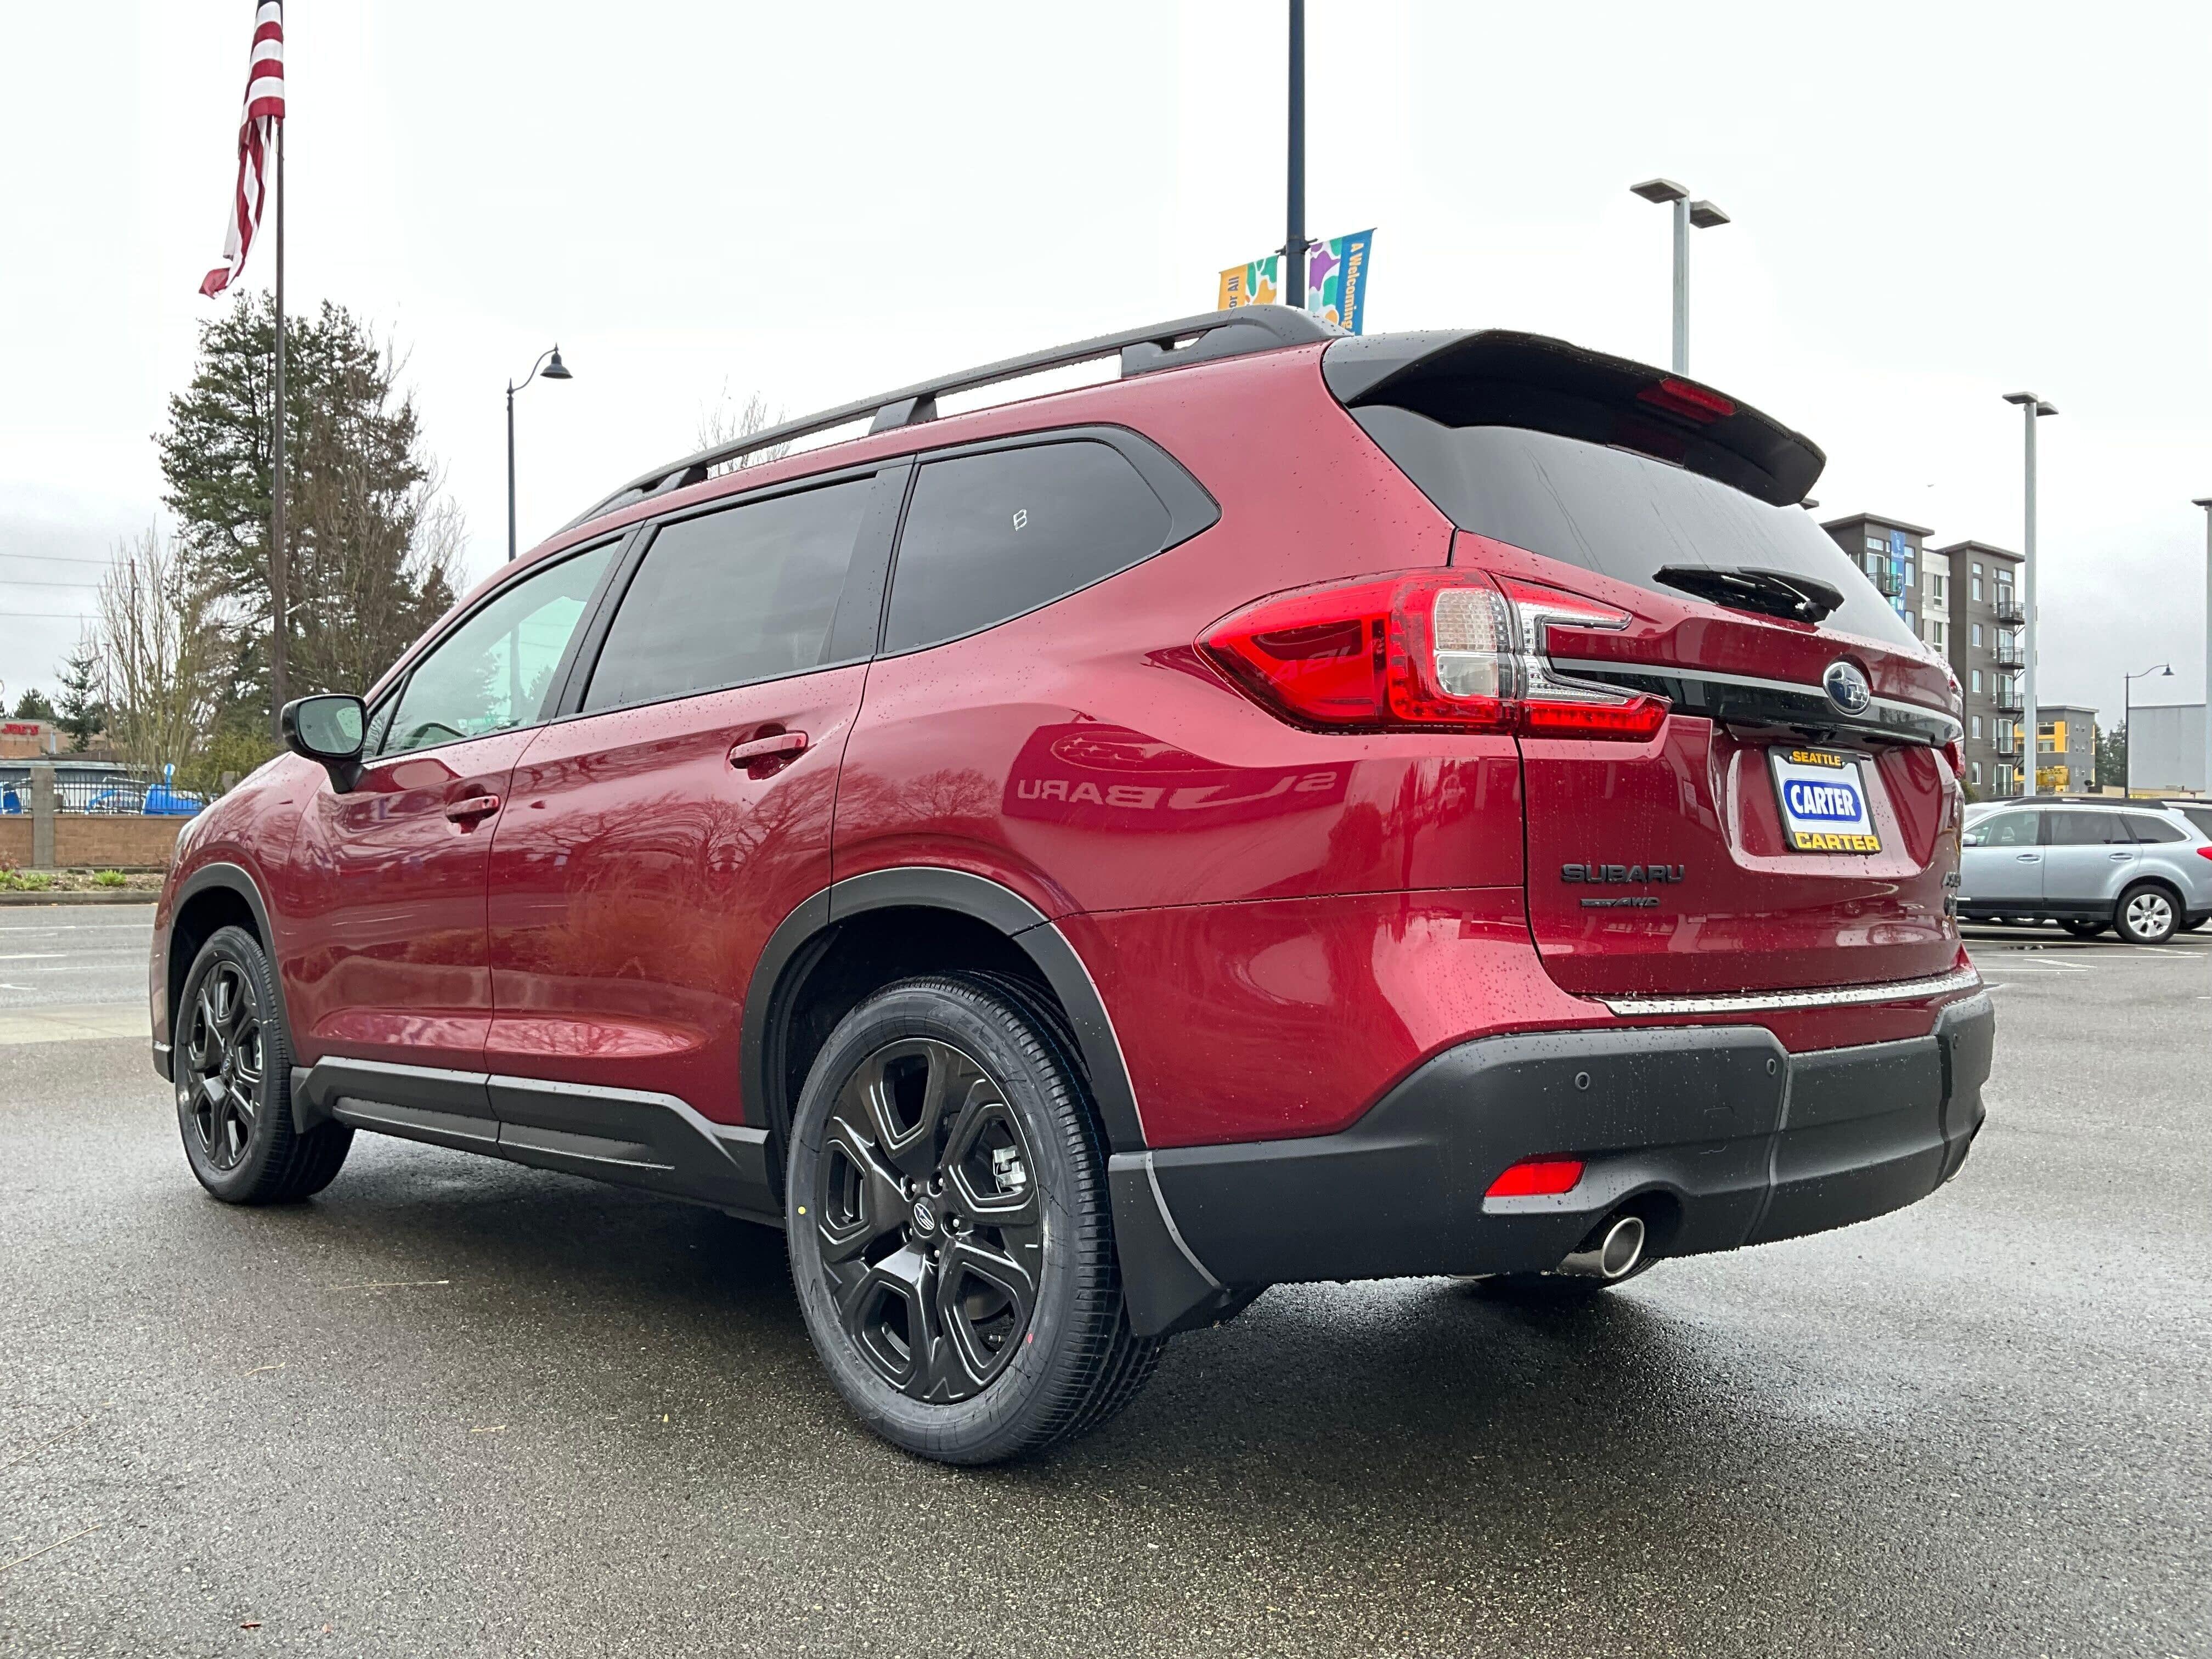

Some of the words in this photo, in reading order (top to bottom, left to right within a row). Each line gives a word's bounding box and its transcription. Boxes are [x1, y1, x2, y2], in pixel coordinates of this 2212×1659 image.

[1351, 243, 1364, 252] A
[1228, 276, 1239, 292] All
[1341, 252, 1362, 329] Welcoming
[1229, 296, 1238, 308] or
[1792, 751, 1841, 766] SEATTLE
[1791, 785, 1856, 816] CARTER
[1795, 832, 1881, 850] CARTER
[1561, 864, 1685, 883] SUBARU
[1615, 897, 1661, 907] AWD
